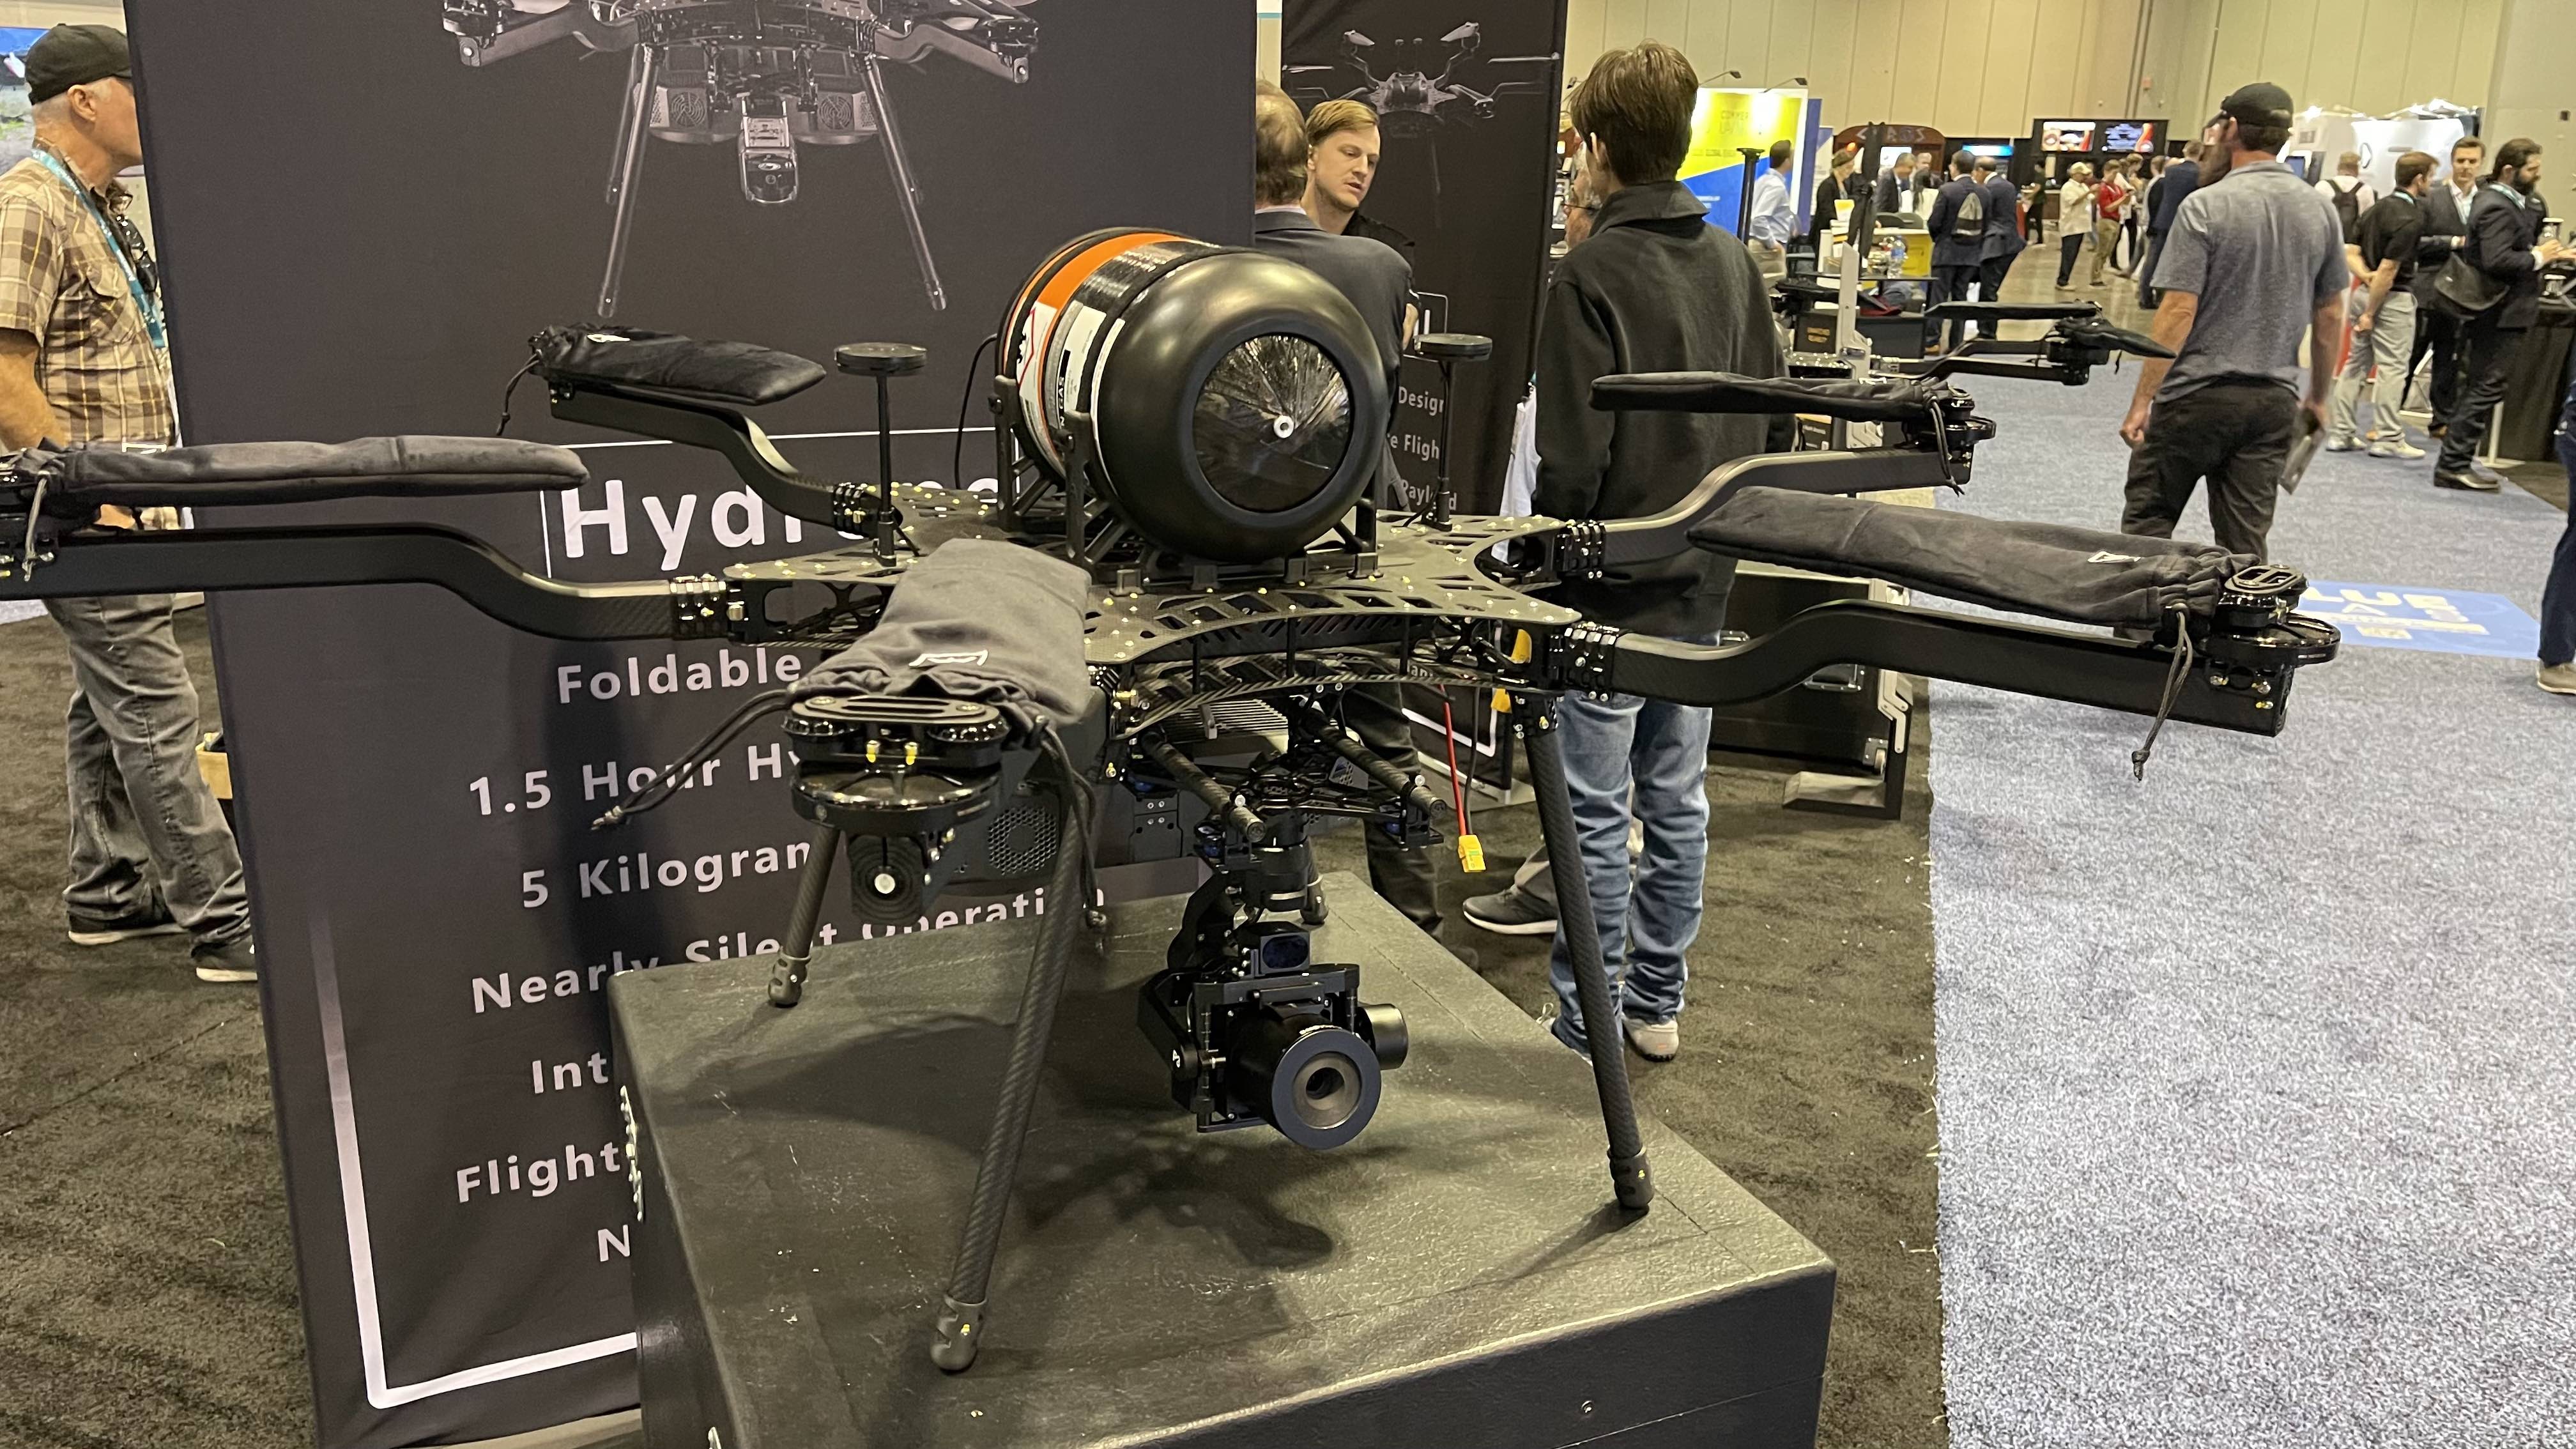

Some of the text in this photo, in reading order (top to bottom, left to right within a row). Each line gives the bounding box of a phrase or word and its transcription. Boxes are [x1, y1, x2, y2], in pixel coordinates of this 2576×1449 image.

[1400, 479, 1457, 510] Payld
[558, 647, 802, 703] Foldable
[470, 770, 551, 815] 1.5
[583, 758, 721, 801] Hour
[523, 870, 548, 908] 5
[685, 923, 838, 963] Silet
[457, 1138, 620, 1204] Flight
